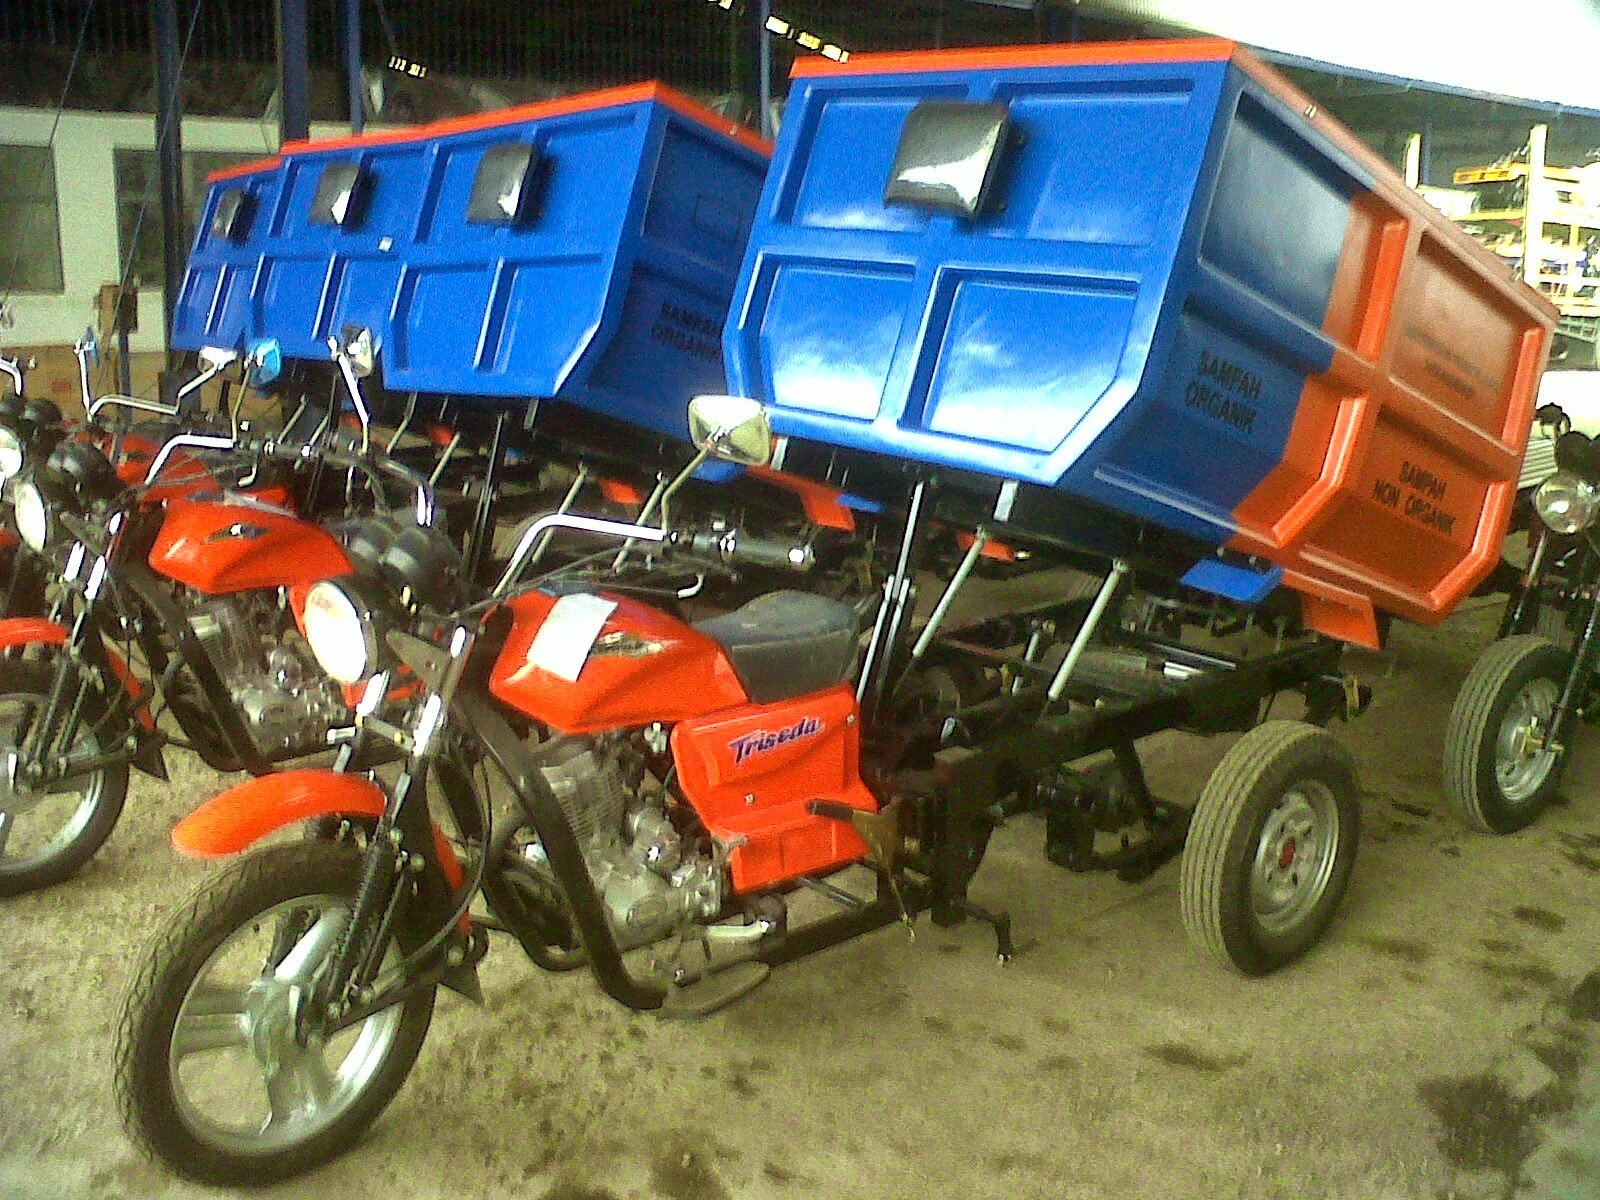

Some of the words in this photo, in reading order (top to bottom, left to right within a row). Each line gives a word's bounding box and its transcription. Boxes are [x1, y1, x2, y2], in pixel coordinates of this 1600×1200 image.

[1198, 350, 1262, 400] SAMPAH
[1184, 380, 1257, 434] ORGANIK
[1399, 460, 1447, 501] SAMPAH
[1372, 479, 1401, 508] NON
[1404, 494, 1457, 536] ORGANIK
[729, 716, 826, 765] Triseda
